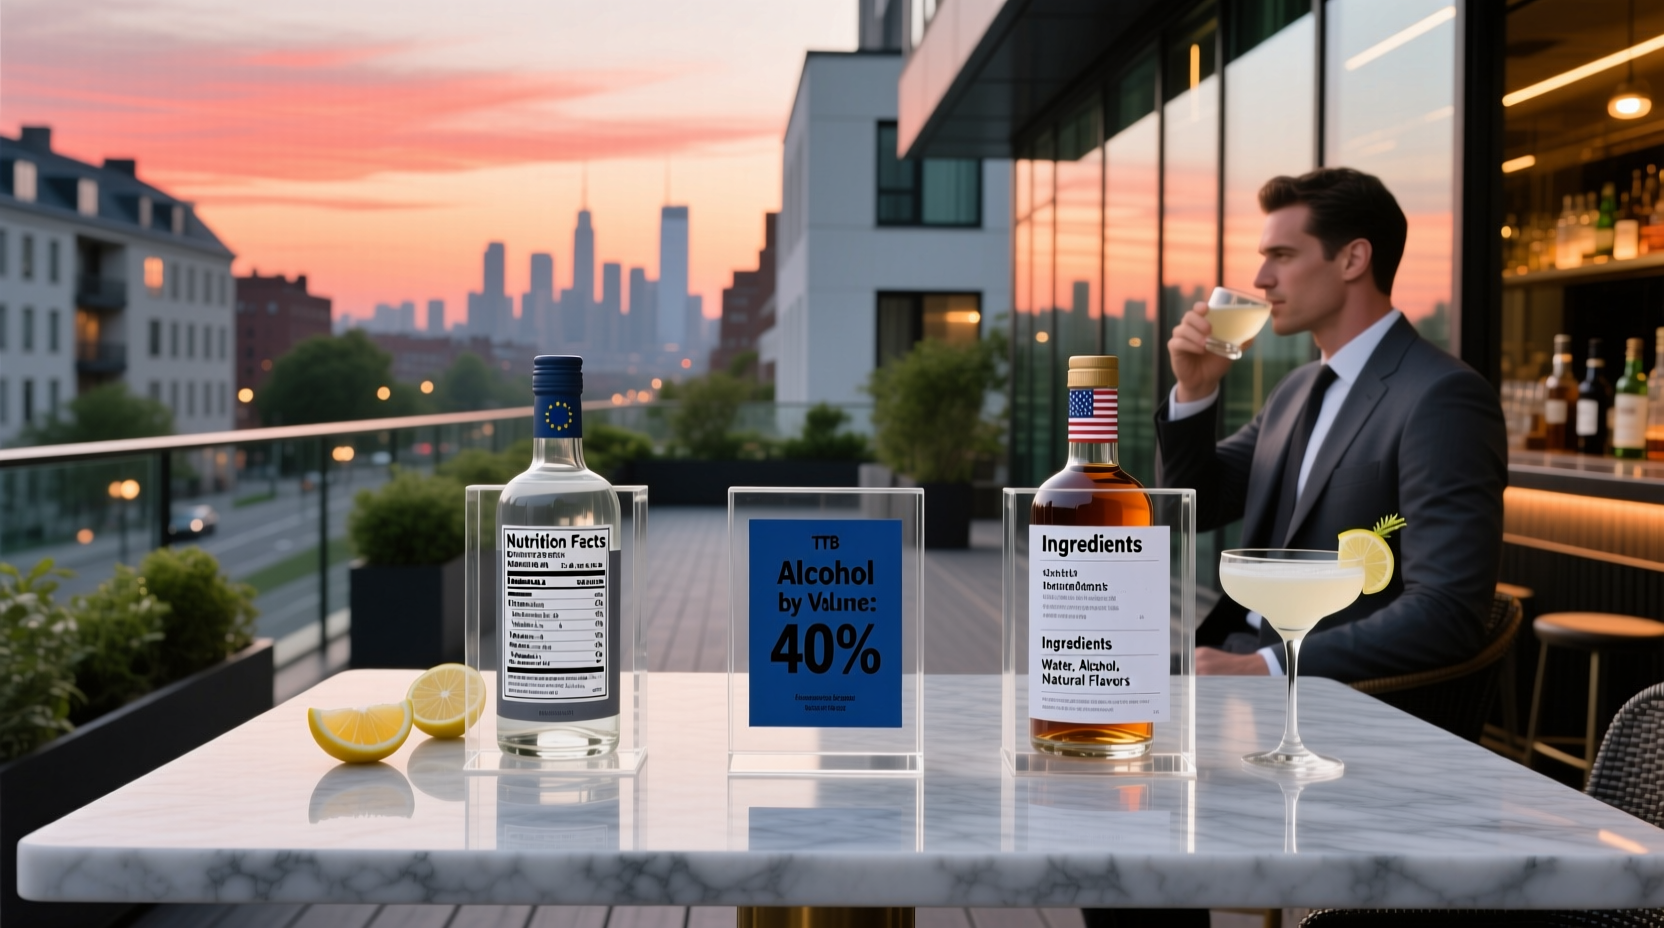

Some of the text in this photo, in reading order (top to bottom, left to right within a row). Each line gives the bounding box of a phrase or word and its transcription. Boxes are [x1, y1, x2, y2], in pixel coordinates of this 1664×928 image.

[506, 533, 606, 549] Nutrition Facts
[811, 535, 840, 550] TTB
[1042, 534, 1142, 557] Ingredients
[776, 560, 874, 585] Alcohol
[778, 592, 802, 617] by
[770, 623, 881, 674] 40%
[1042, 636, 1112, 652] Ingredients
[1042, 658, 1076, 672] Water,
[1042, 673, 1130, 687] Natural Flavors
